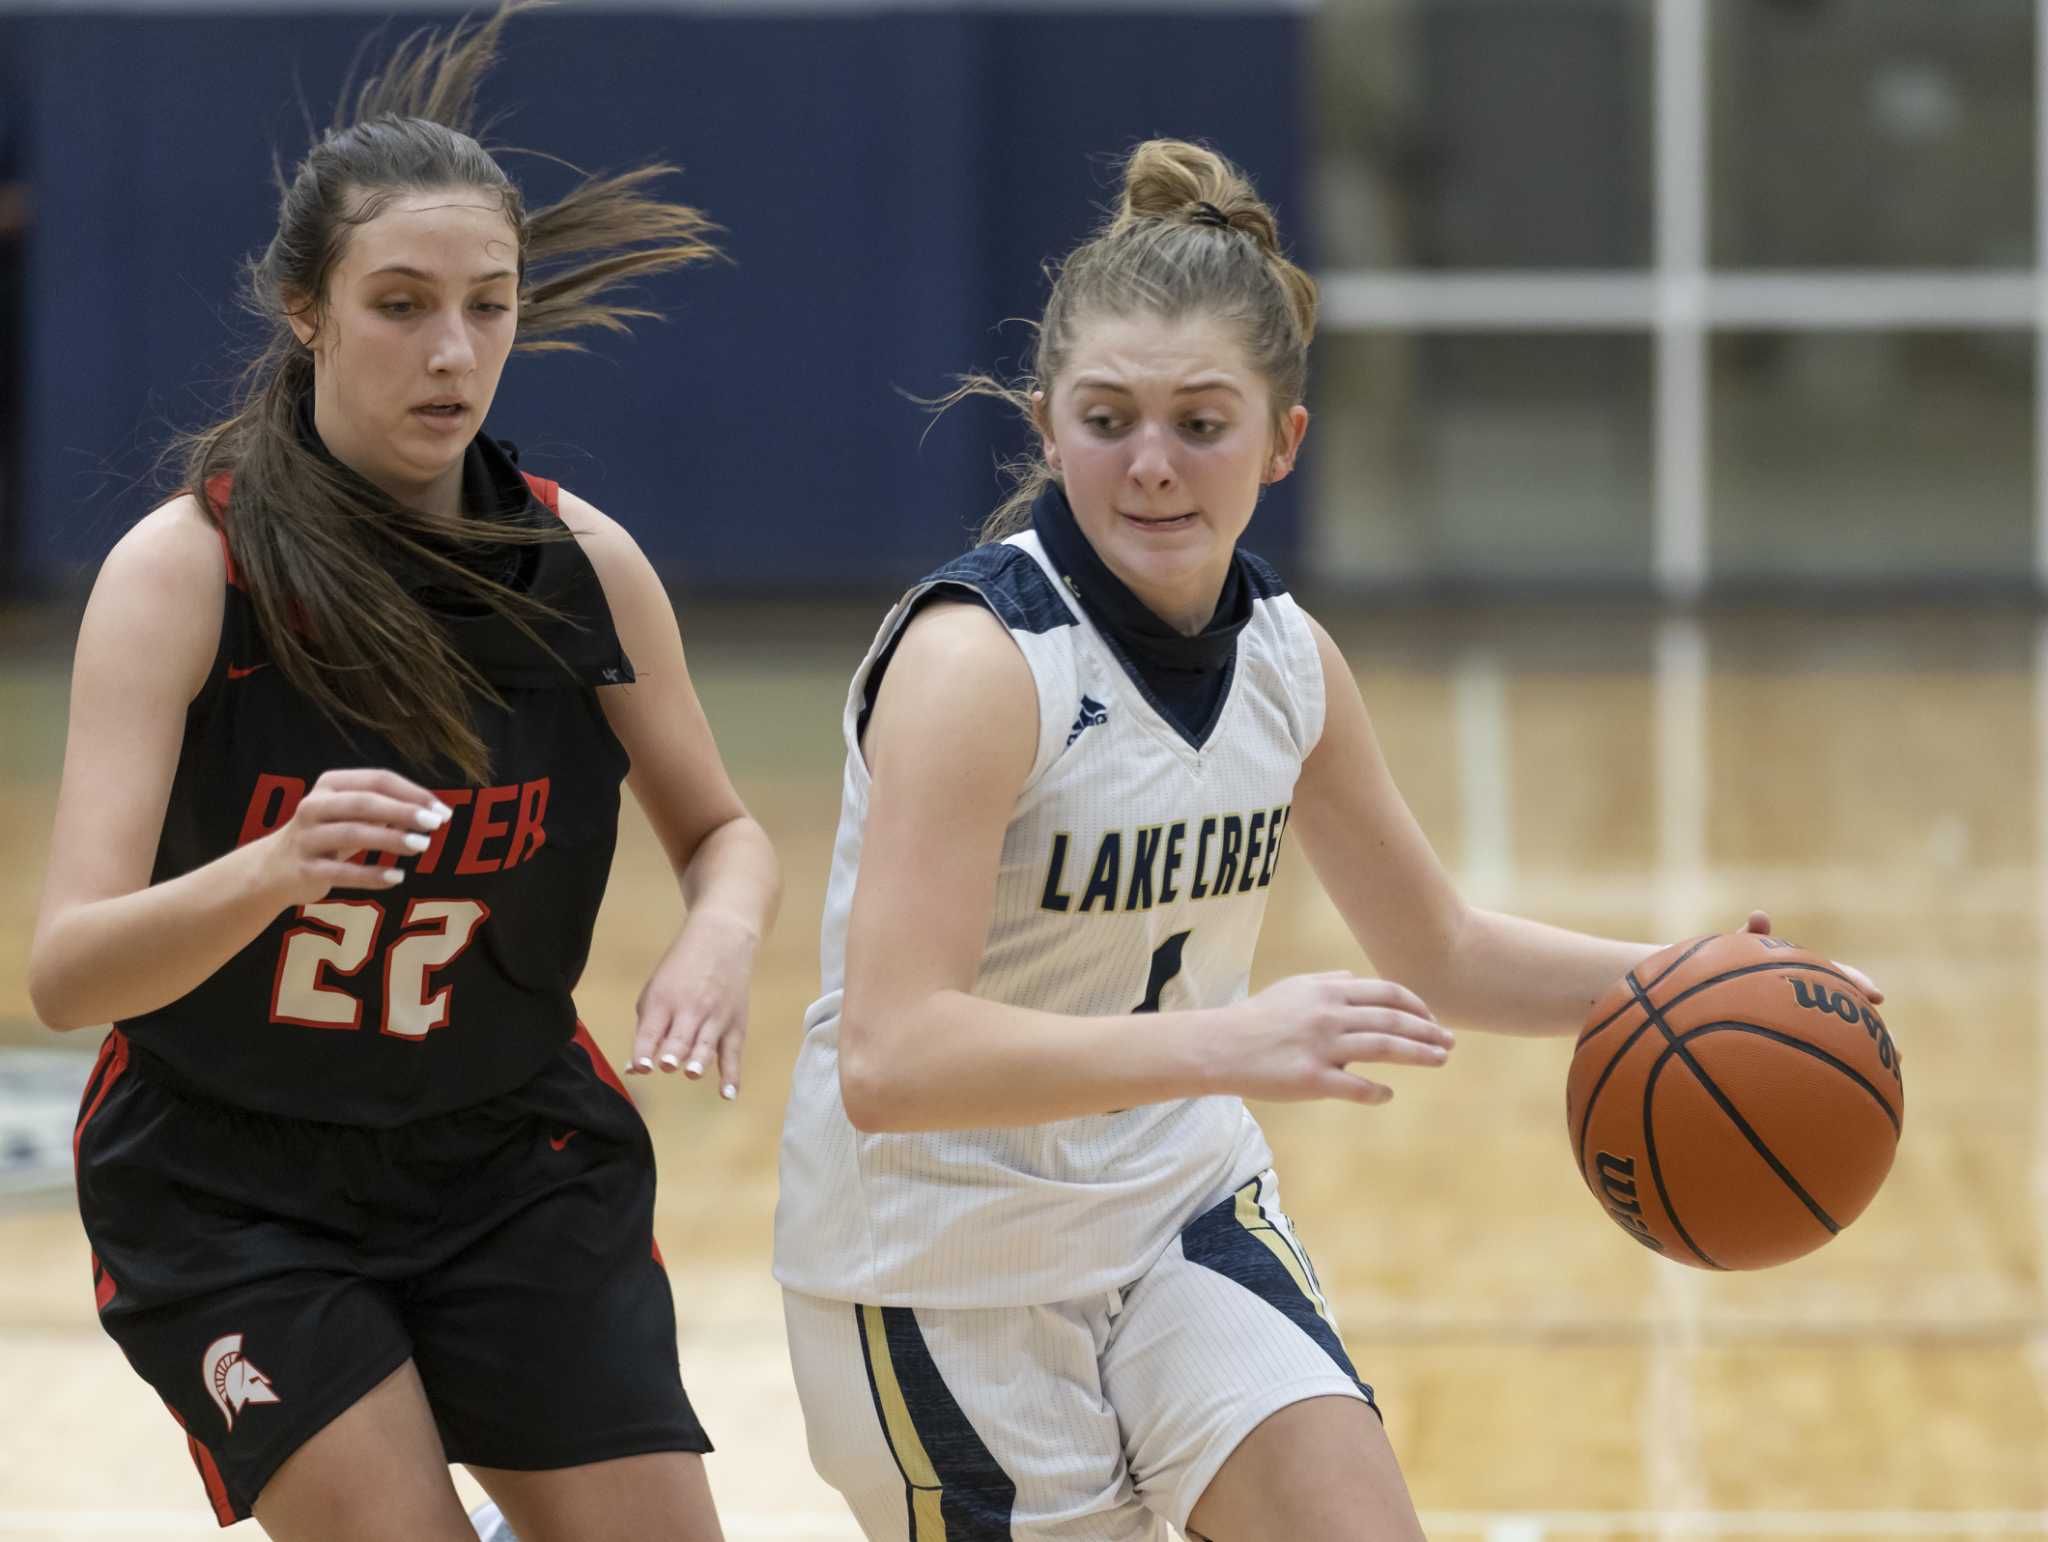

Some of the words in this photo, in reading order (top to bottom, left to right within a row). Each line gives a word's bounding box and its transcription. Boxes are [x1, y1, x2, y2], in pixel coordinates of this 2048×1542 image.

[236, 773, 550, 876] PTER
[1040, 819, 1188, 914] LAKE
[1189, 803, 1292, 902] CREE
[268, 897, 491, 1041] 22
